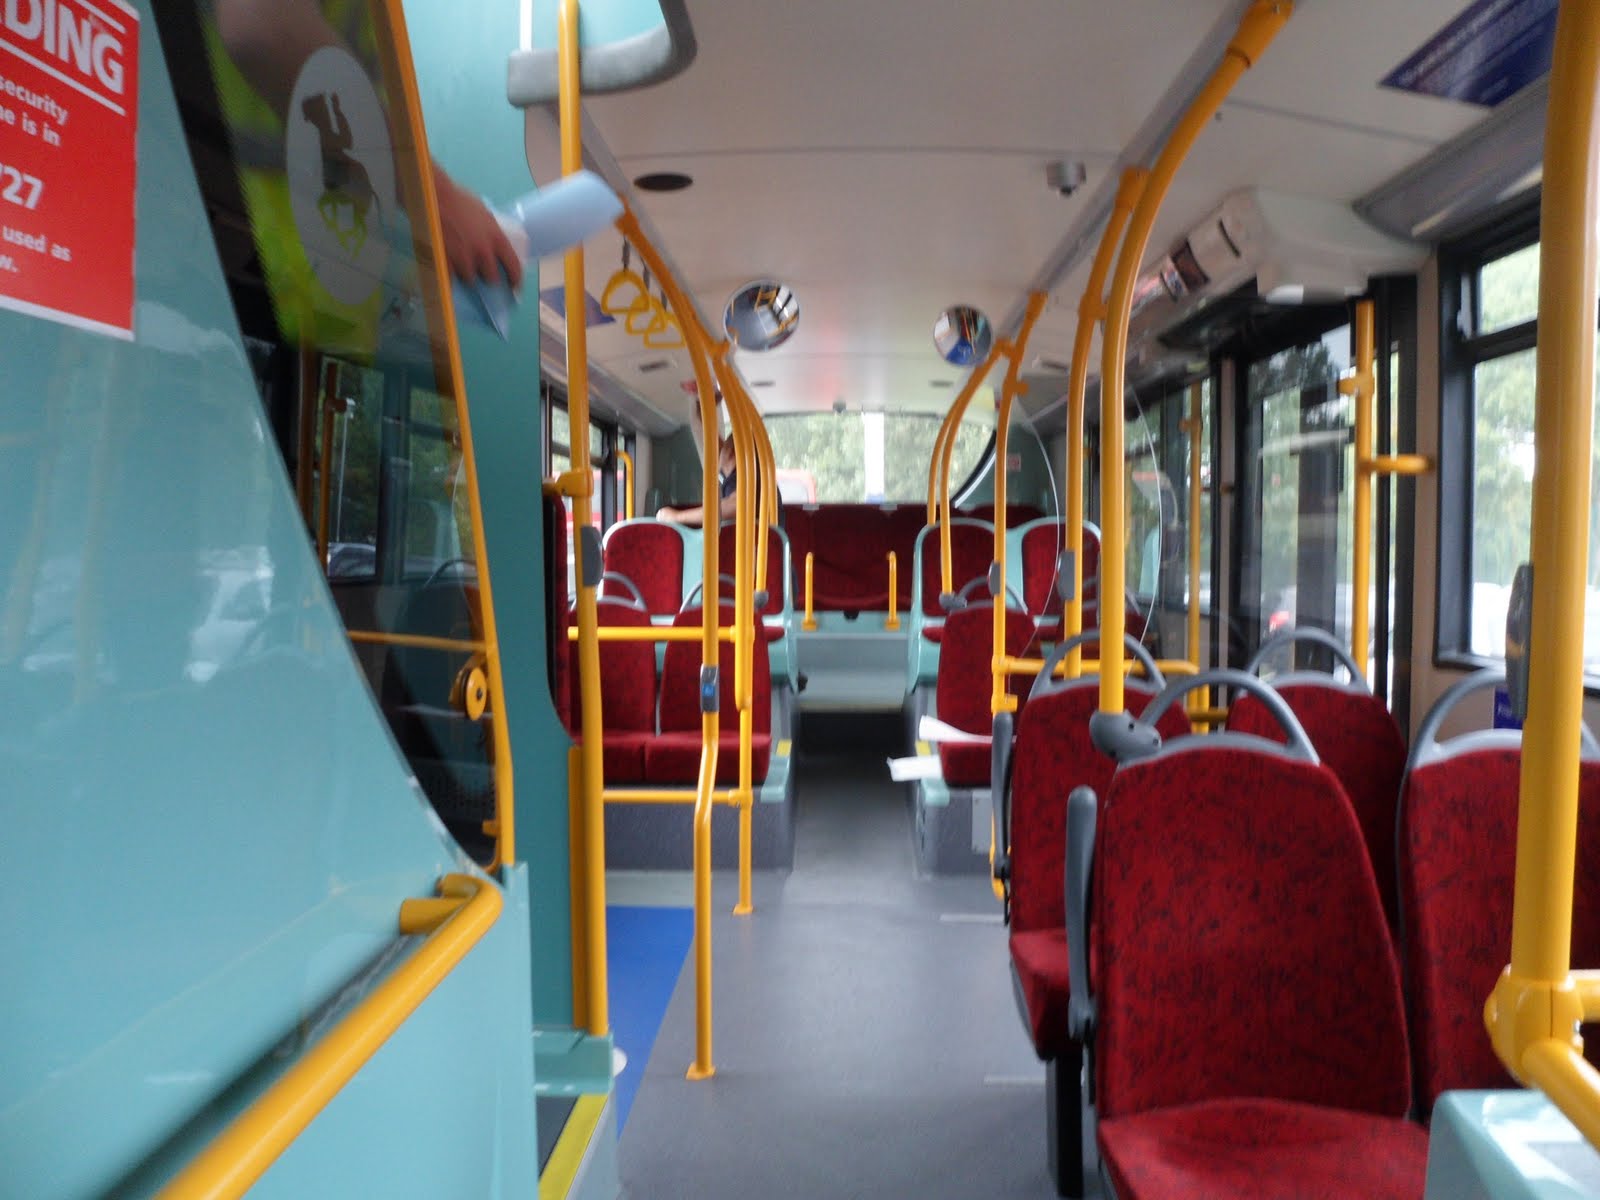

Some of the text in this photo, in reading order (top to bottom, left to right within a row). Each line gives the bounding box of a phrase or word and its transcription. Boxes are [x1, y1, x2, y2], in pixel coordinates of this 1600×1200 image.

[0, 0, 124, 94] DING
[22, 111, 37, 136] is
[43, 121, 60, 147] in
[0, 162, 43, 210] 27
[3, 225, 72, 263] used as
